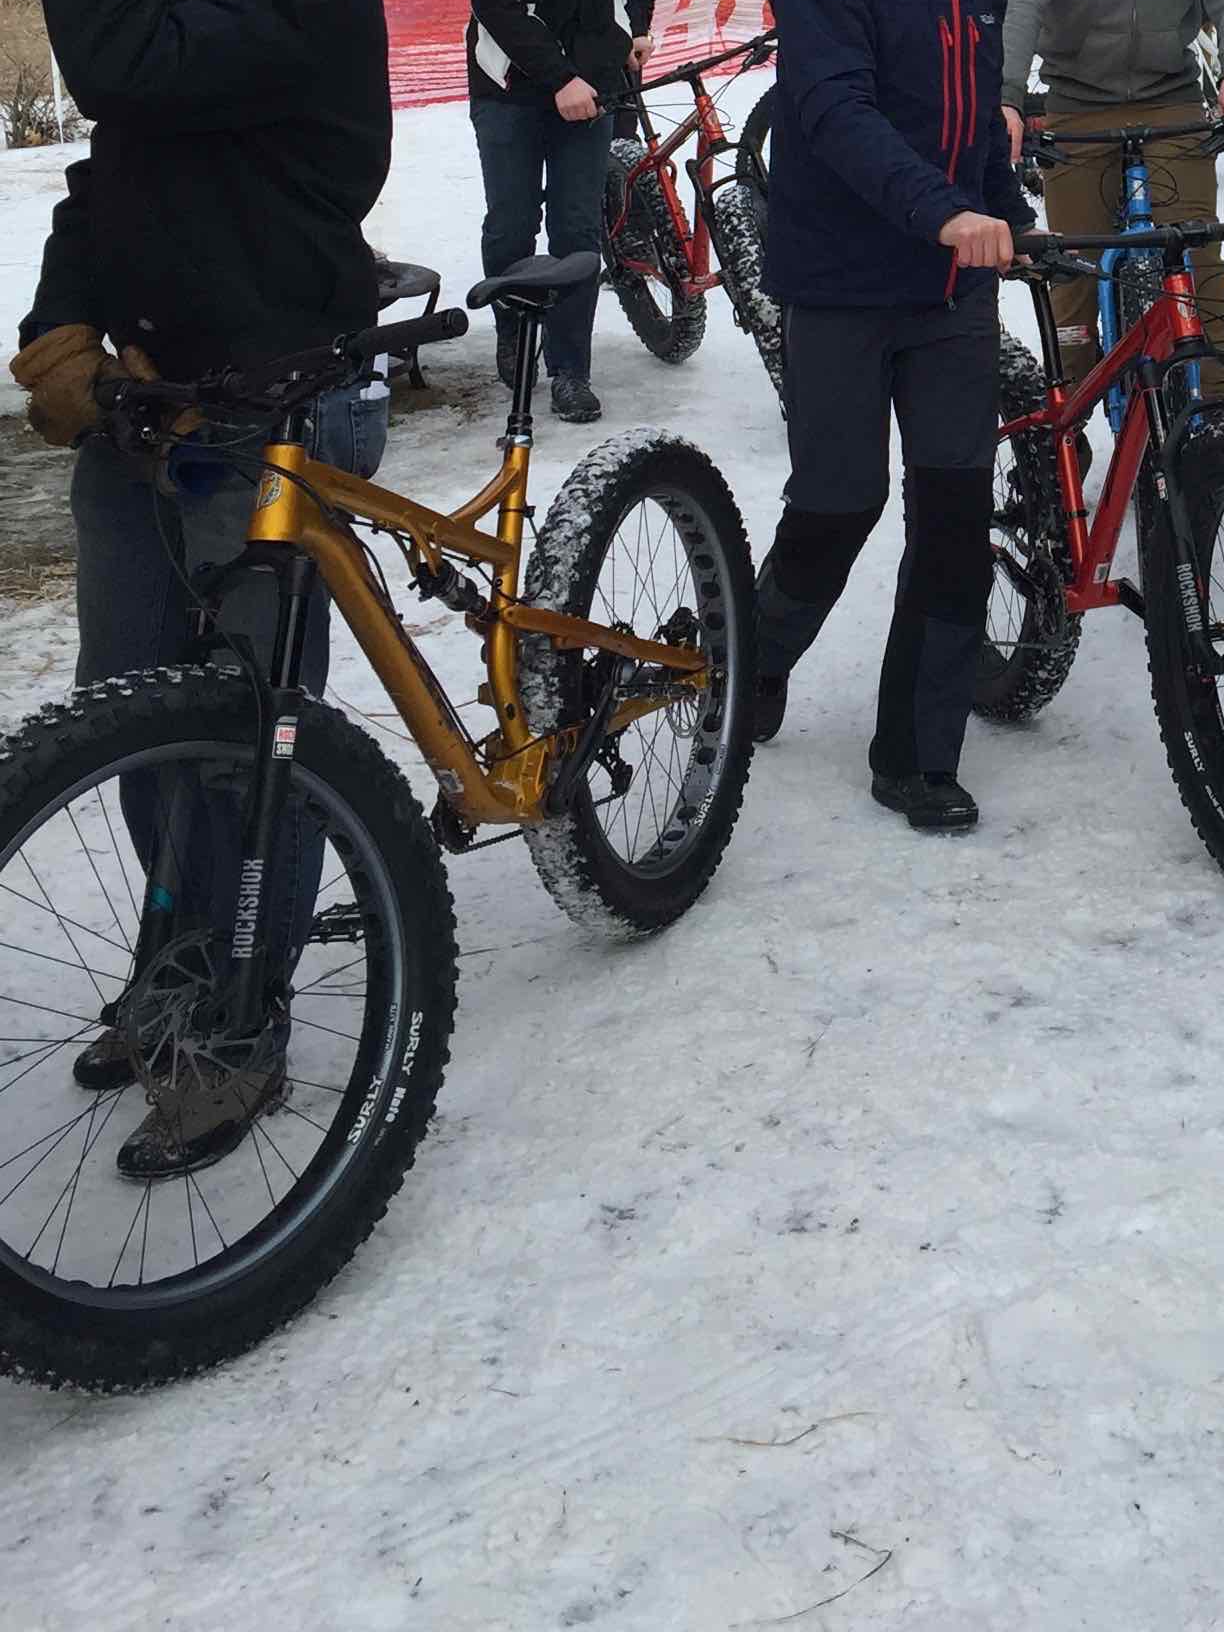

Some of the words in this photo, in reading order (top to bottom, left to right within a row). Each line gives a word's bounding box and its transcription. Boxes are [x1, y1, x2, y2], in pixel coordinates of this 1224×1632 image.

[1176, 562, 1204, 632] ROCKSHOX
[1184, 730, 1206, 772] SURLY
[693, 788, 715, 827] SURLY
[231, 858, 265, 959] ROCKSHOX
[402, 1010, 424, 1076] SURLY
[346, 1074, 384, 1144] SURLY
